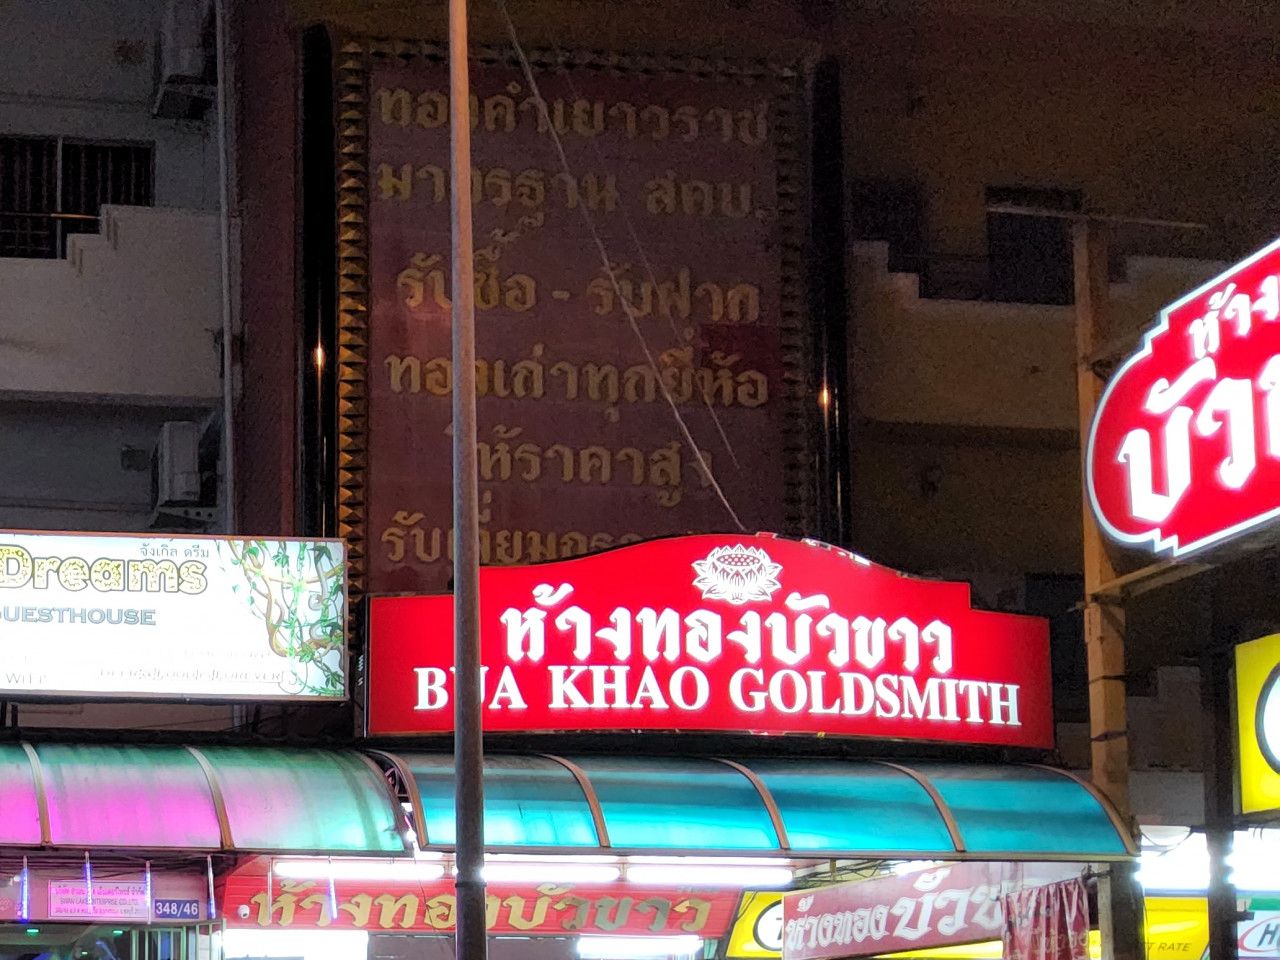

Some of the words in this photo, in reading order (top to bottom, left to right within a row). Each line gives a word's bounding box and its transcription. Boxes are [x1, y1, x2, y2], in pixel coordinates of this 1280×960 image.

[498, 580, 954, 674] ห้างทองบัวขาว
[413, 662, 530, 711] BA
[547, 663, 711, 712] KHAO
[727, 664, 1022, 727] GOLDSMITH
[155, 902, 198, 917] 348/46
[250, 879, 715, 933] ห้างทอบัวขาว
